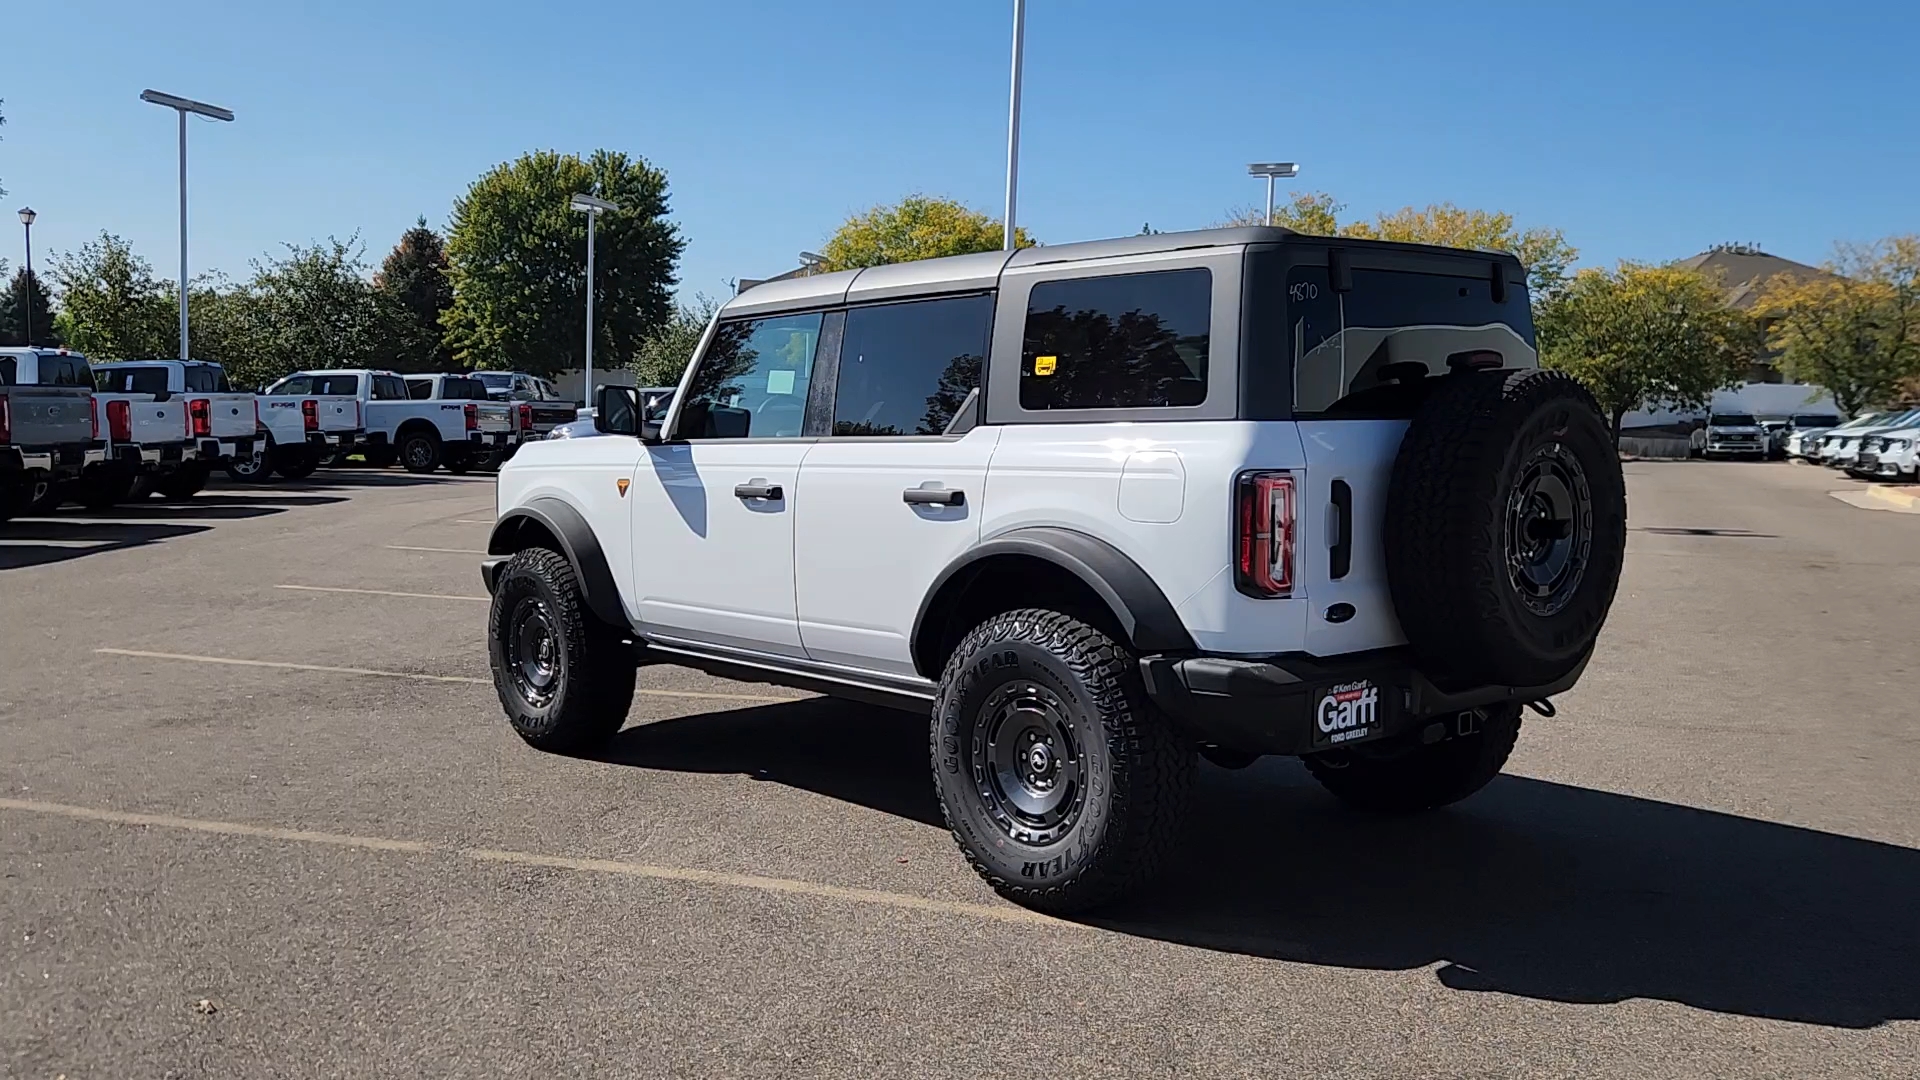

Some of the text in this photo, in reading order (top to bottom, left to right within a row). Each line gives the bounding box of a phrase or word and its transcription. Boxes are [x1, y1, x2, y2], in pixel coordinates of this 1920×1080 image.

[1289, 281, 1318, 303] 4870
[1317, 687, 1378, 733] Garff
[1331, 727, 1368, 744] FORD GREELEY
